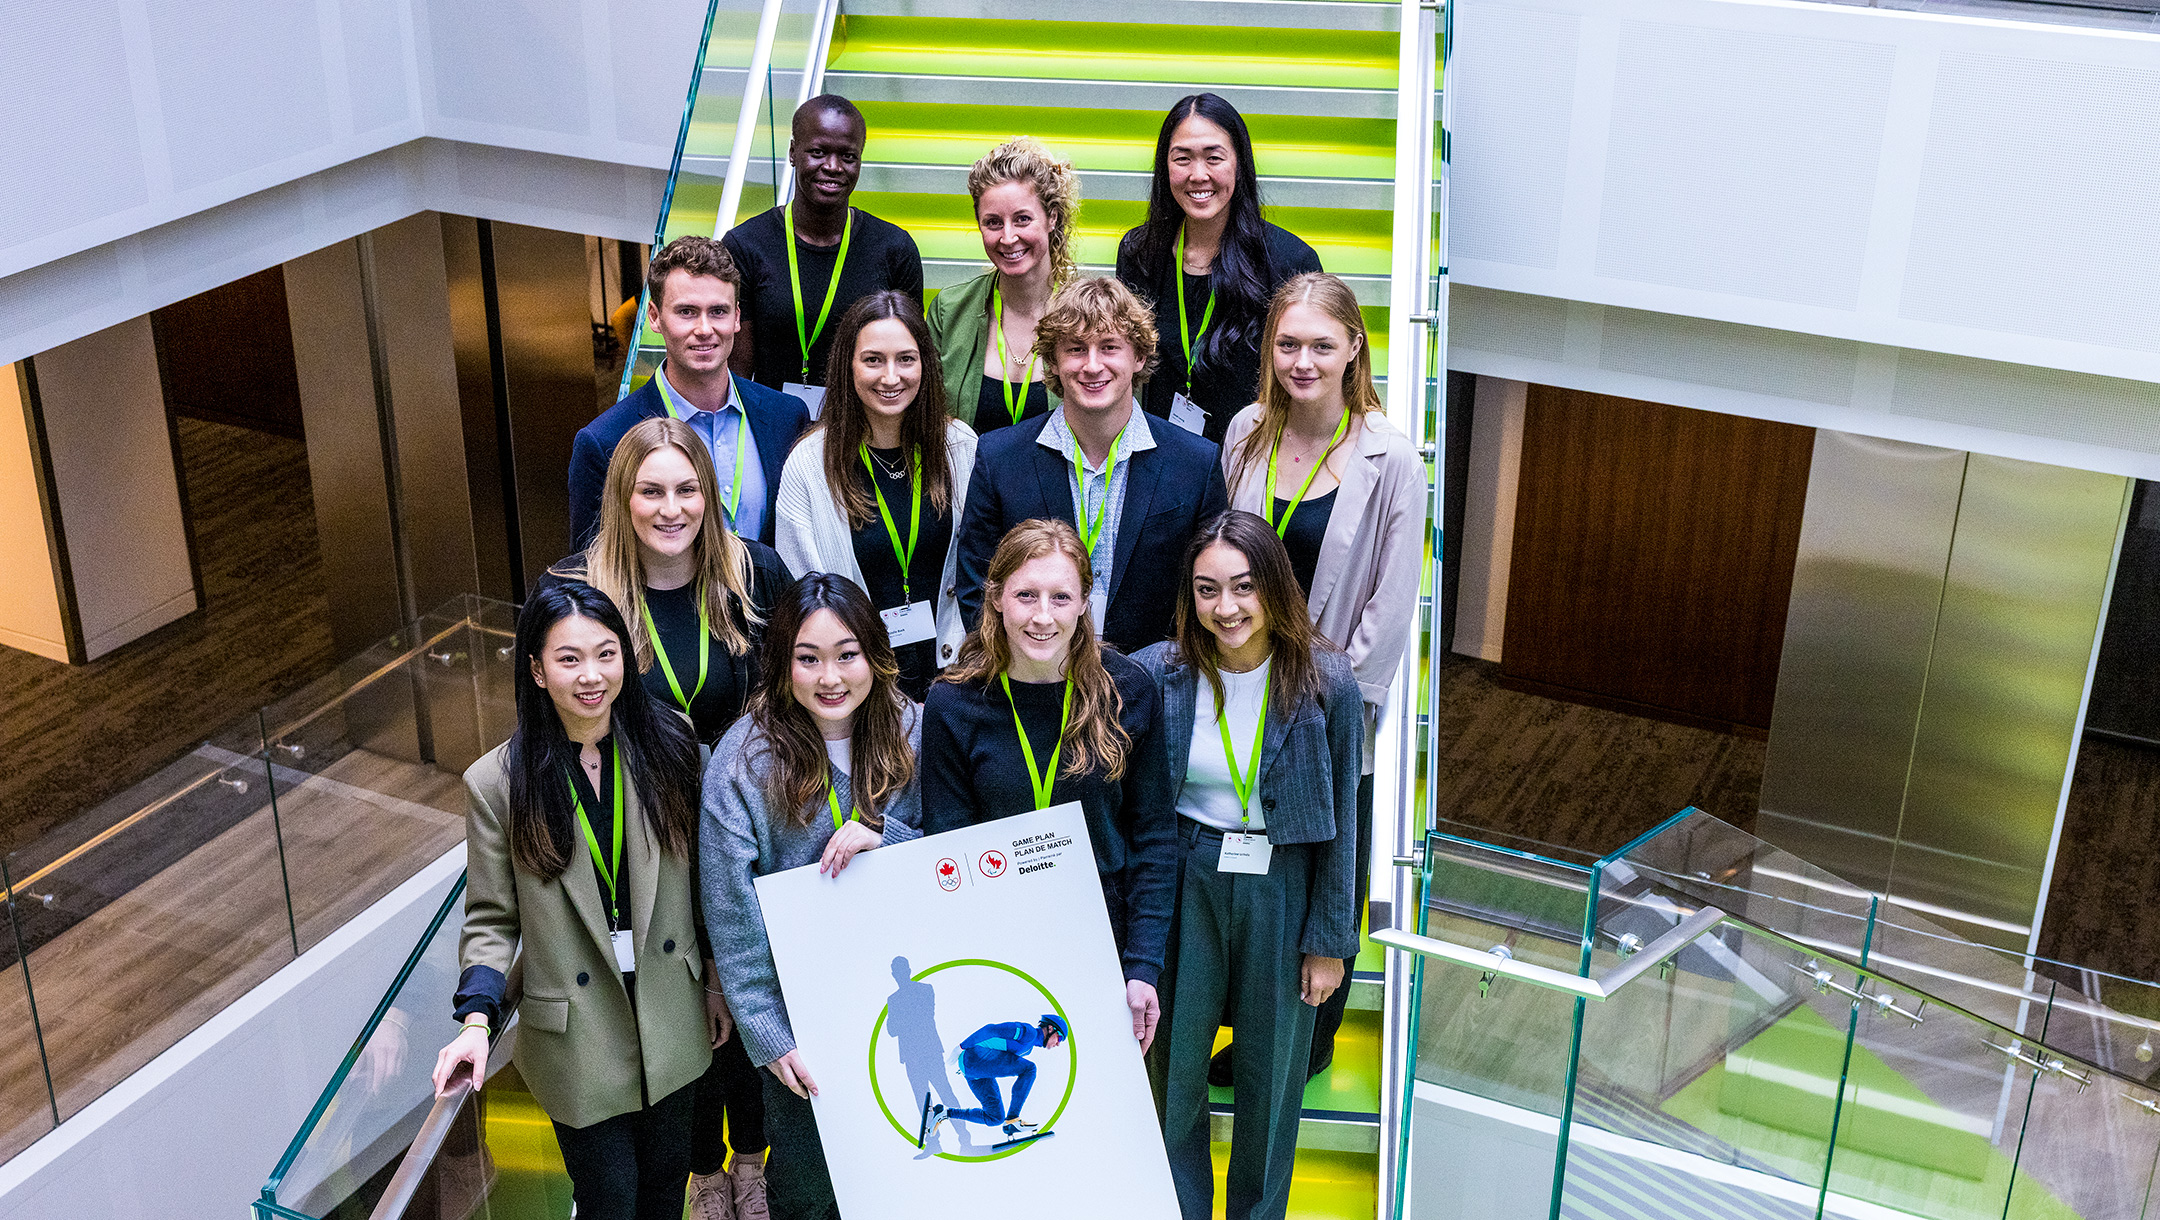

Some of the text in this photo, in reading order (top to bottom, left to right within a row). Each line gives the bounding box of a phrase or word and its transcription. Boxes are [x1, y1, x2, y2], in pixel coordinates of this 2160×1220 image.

[1012, 832, 1055, 847] GAME PLAN
[1014, 838, 1073, 857] PLAN DE MATCH
[1018, 861, 1057, 875] Deloitte.
